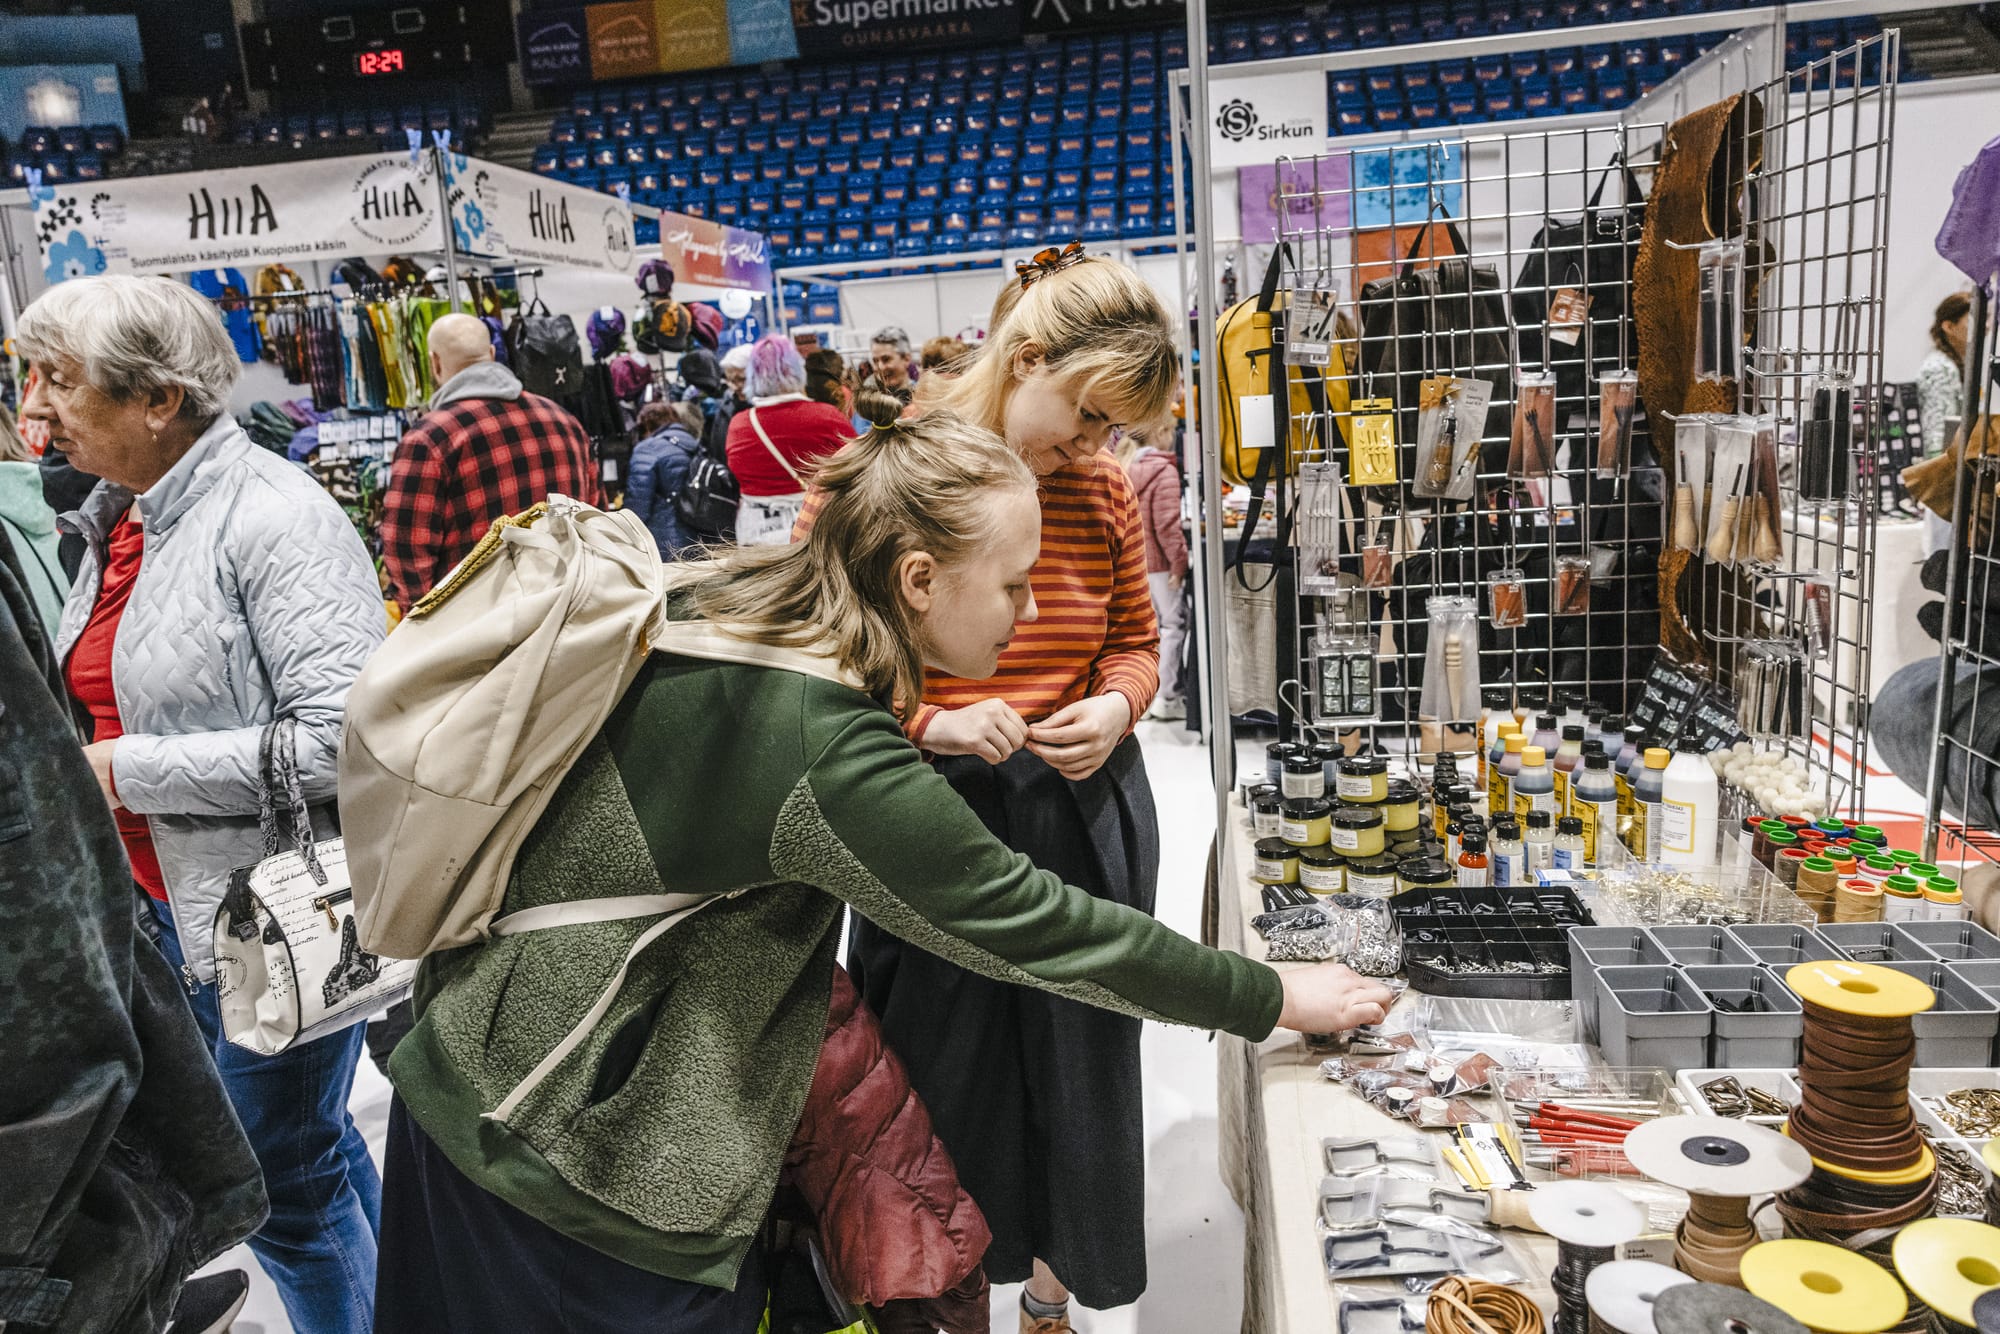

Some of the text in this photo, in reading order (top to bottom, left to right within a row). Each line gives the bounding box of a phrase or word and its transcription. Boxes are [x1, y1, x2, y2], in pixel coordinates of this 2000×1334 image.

[360, 50, 403, 74] 12:29
[1258, 123, 1313, 141] Sirkun
[131, 240, 347, 269] Suomalaista käsityötä Kuopiosta käsin
